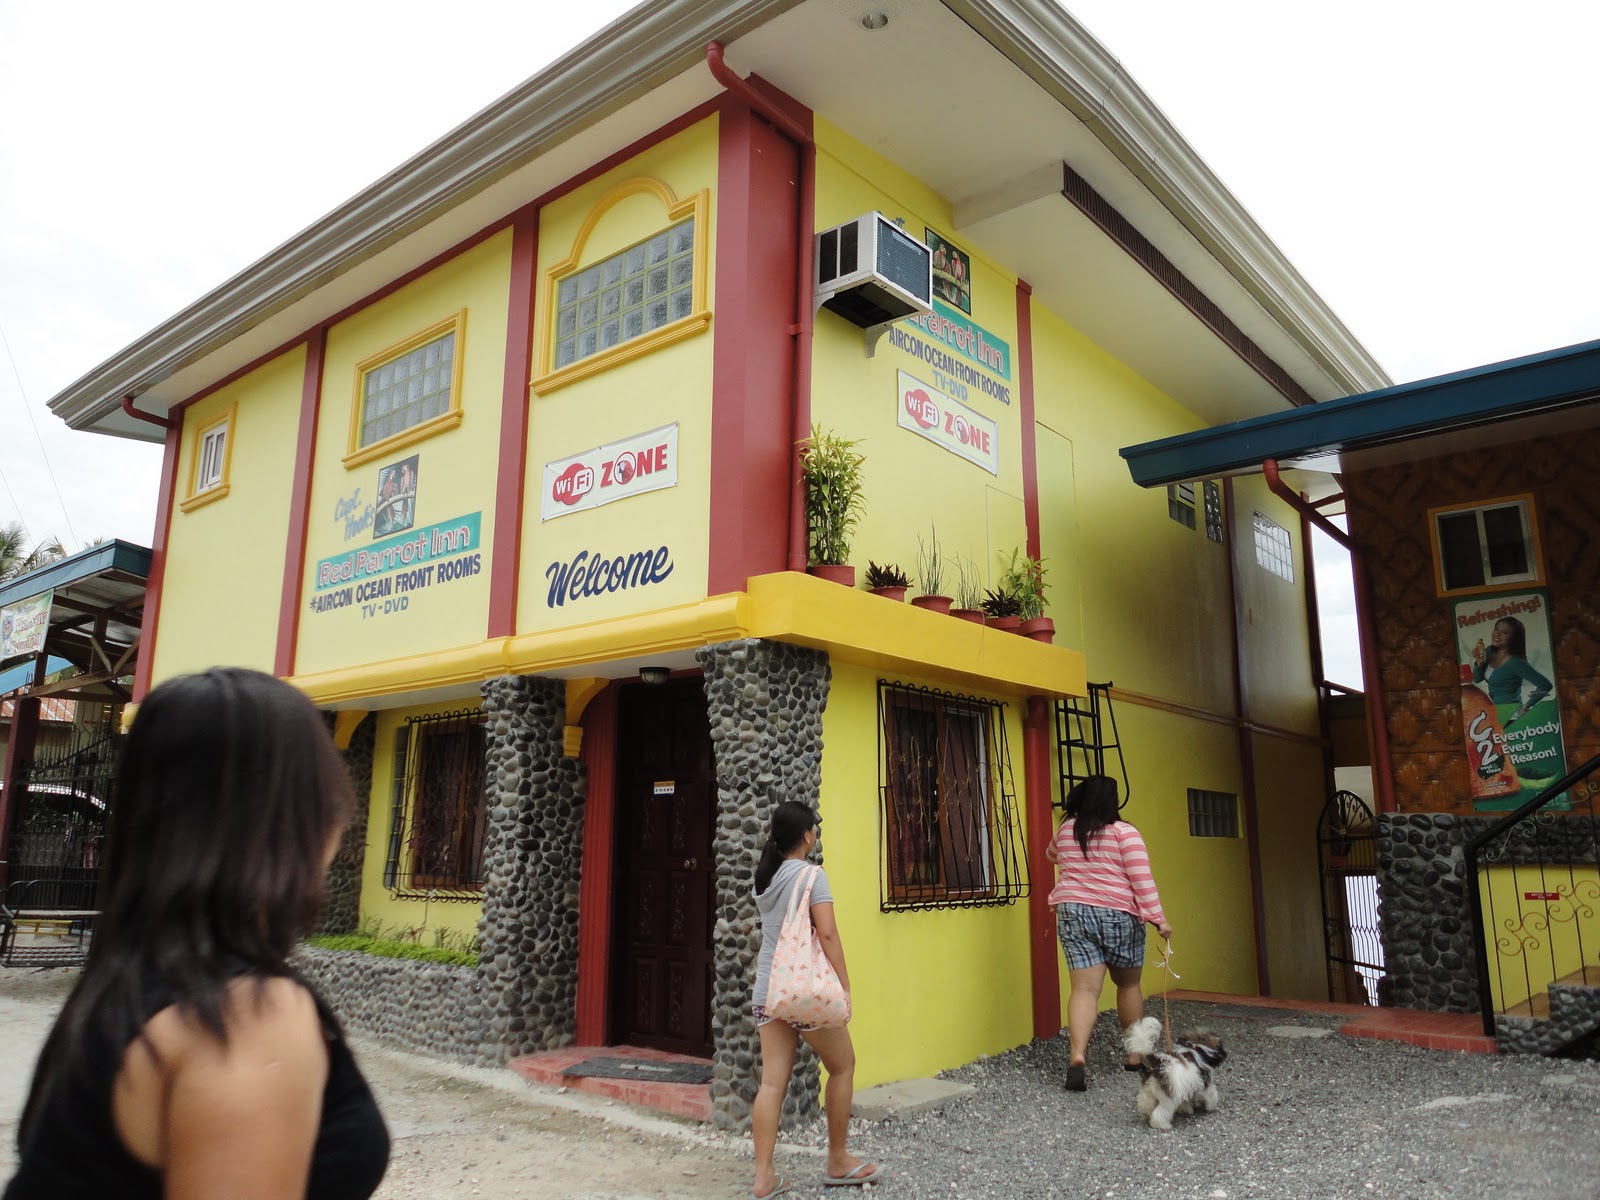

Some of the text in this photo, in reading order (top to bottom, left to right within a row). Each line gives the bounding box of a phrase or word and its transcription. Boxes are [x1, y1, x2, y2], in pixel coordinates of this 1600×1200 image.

[889, 327, 1010, 406] AIRCON OCEAN FRONT ROOMS
[977, 331, 1004, 374] Inn
[944, 410, 990, 454] ZONE
[600, 443, 668, 488] ZONE
[318, 525, 471, 588] Red Parrot Inn
[356, 577, 392, 603] OCEAN
[395, 565, 434, 594] FRONT
[437, 553, 481, 584] ROOMS
[546, 546, 674, 608] Welcome
[1457, 595, 1542, 628] Refreshing!
[1492, 721, 1560, 744] Everybody
[1501, 740, 1534, 755] Every
[1510, 746, 1557, 765] Reason!
